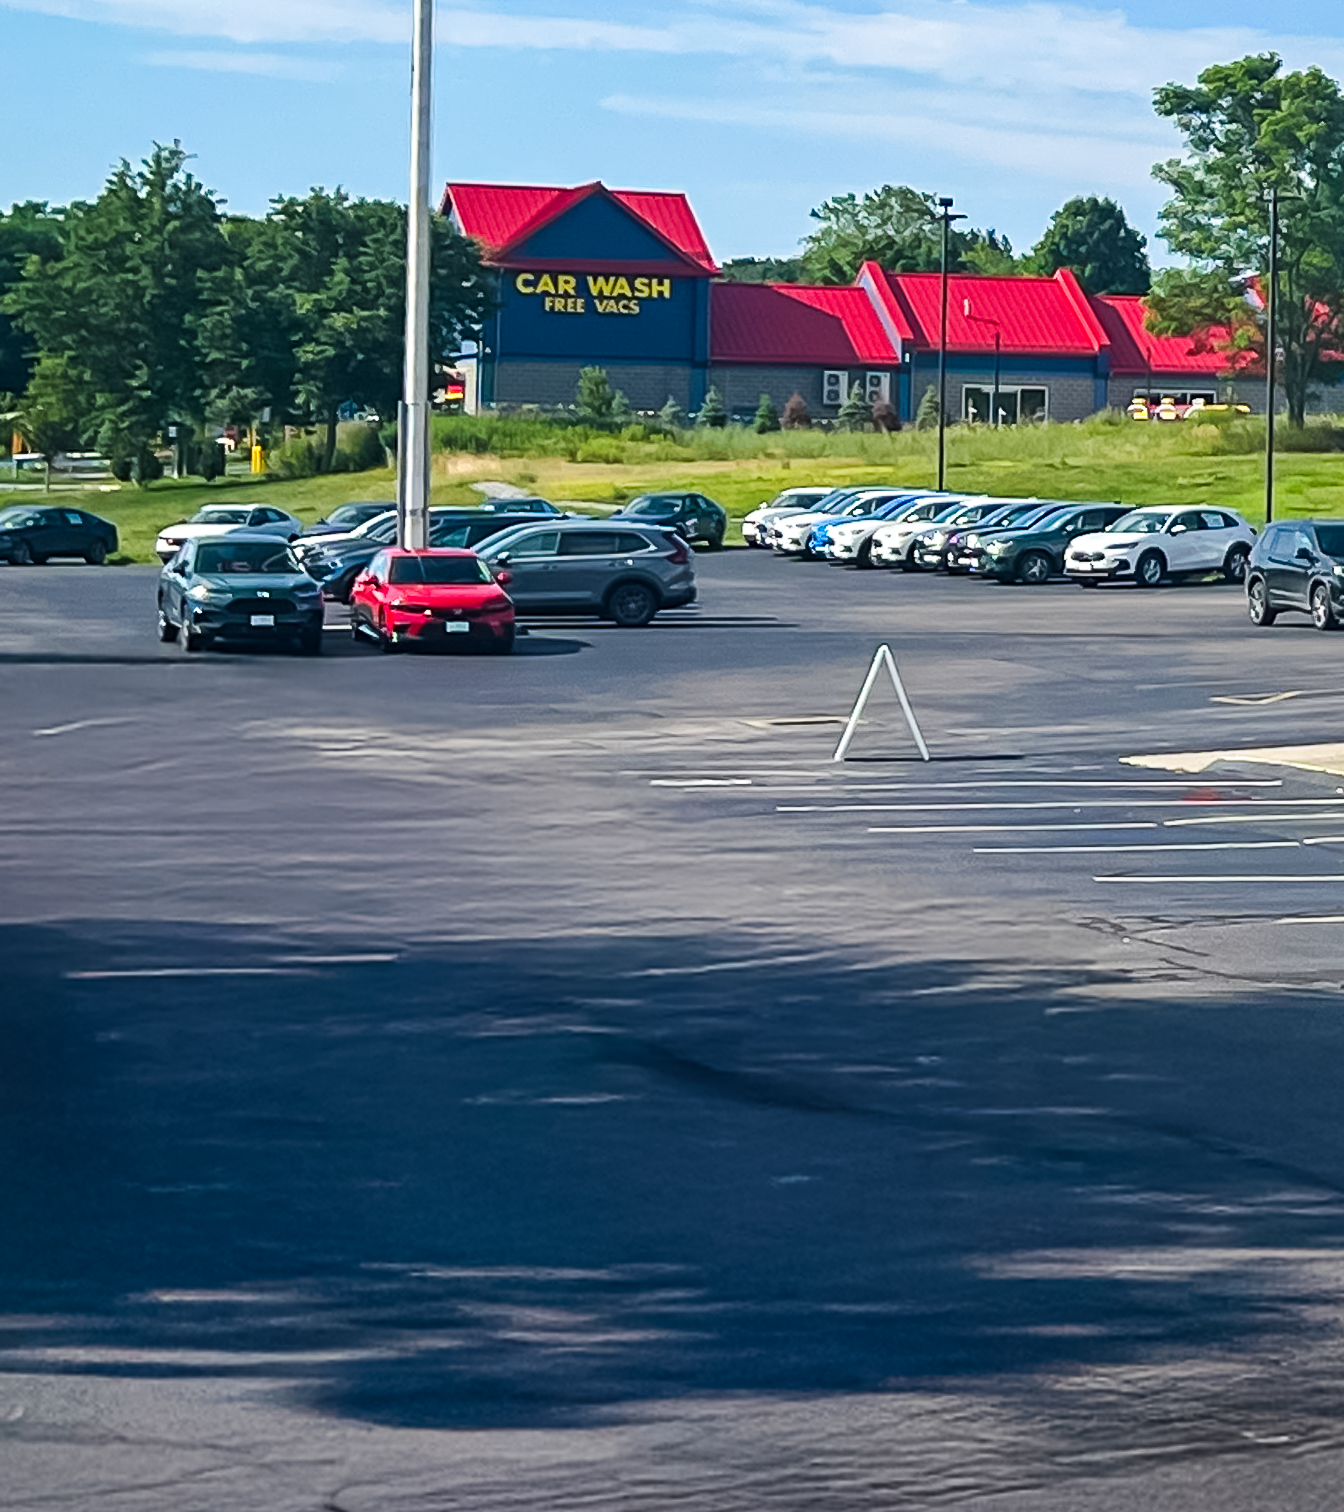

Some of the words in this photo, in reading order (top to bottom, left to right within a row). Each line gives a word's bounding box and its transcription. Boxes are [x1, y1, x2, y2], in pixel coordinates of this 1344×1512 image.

[516, 273, 577, 295] CAR
[586, 275, 671, 299] WASH
[544, 297, 585, 313] FREE
[593, 299, 640, 315] VACS
